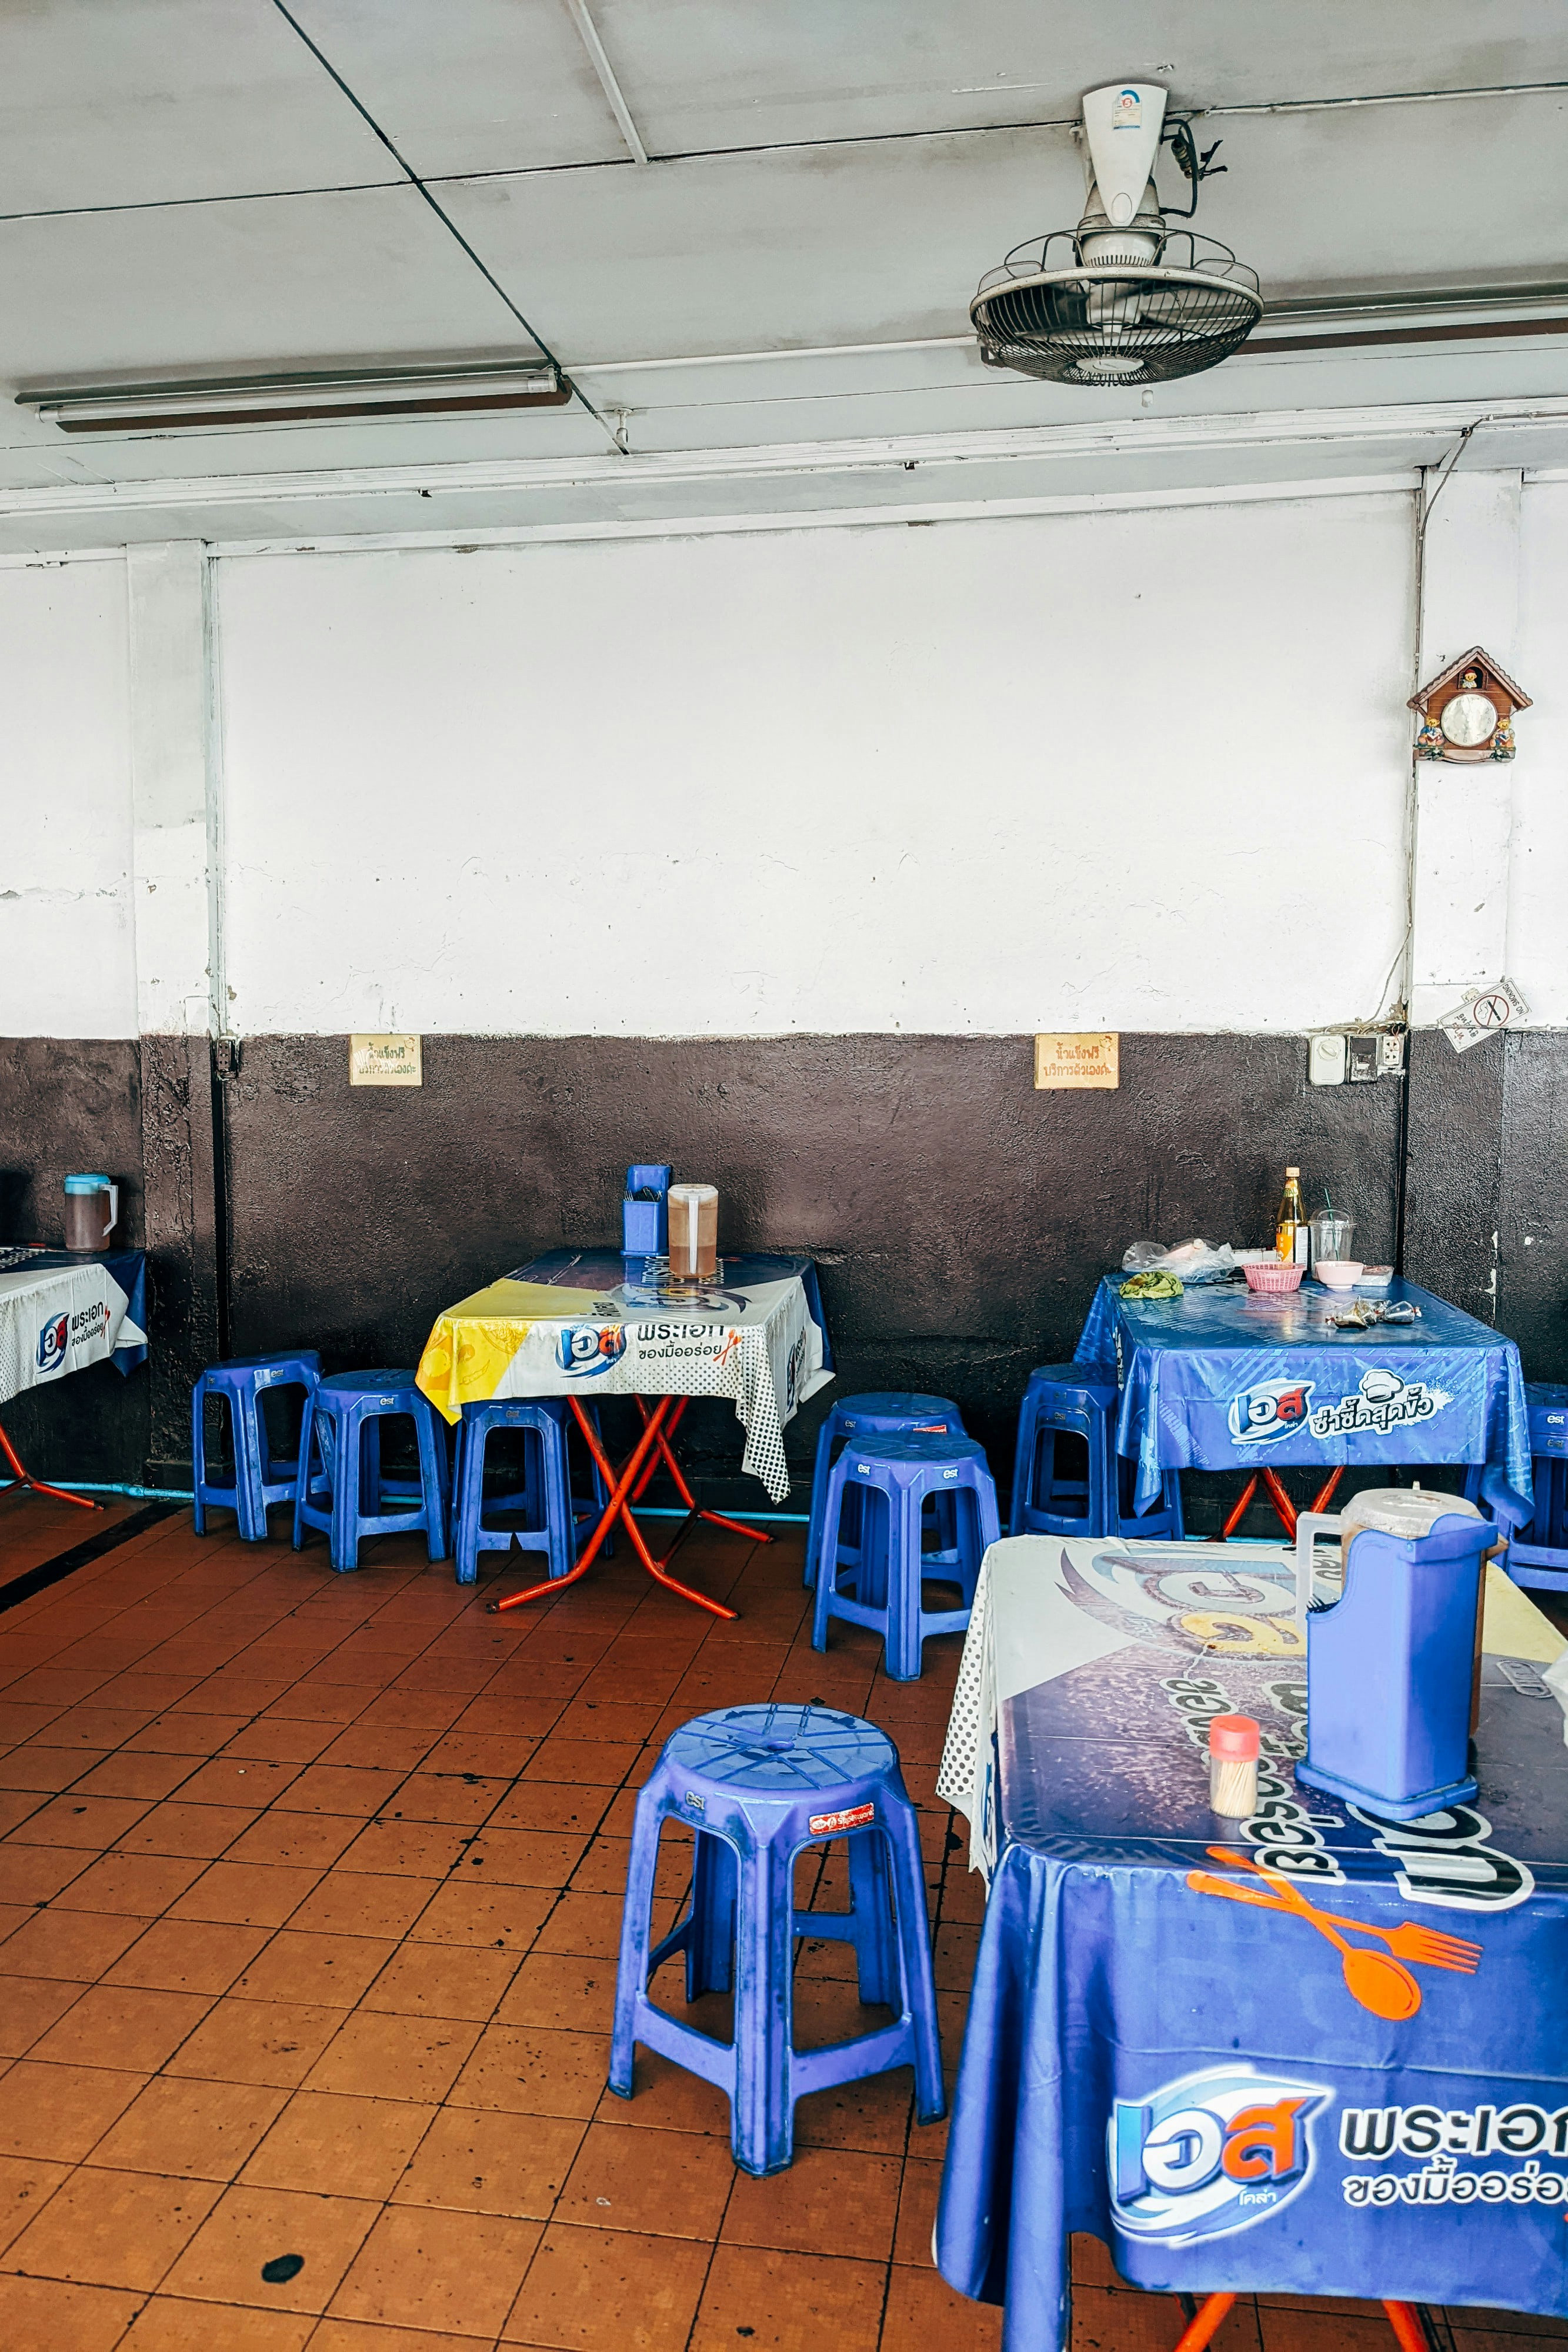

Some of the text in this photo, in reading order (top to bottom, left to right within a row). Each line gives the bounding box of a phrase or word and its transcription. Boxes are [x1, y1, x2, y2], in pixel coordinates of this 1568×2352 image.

[1502, 984, 1525, 1015] NO SMOKING
[1056, 1042, 1099, 1059] น้ำแข็งฟรี
[72, 1302, 104, 1331] พระเอก
[639, 1340, 722, 1360] ของมื้ออร่อย
[380, 1397, 395, 1406] est
[1238, 1387, 1309, 1434] เอส
[1547, 1415, 1565, 1424] est
[858, 1463, 871, 1476] est
[943, 1468, 959, 1479] est
[1342, 2107, 1568, 2157] พระเอ
[1117, 2097, 1317, 2206] เอส
[1345, 2156, 1568, 2203] ของมื้ออร่อ
[1239, 2187, 1277, 2206] โคล่า
